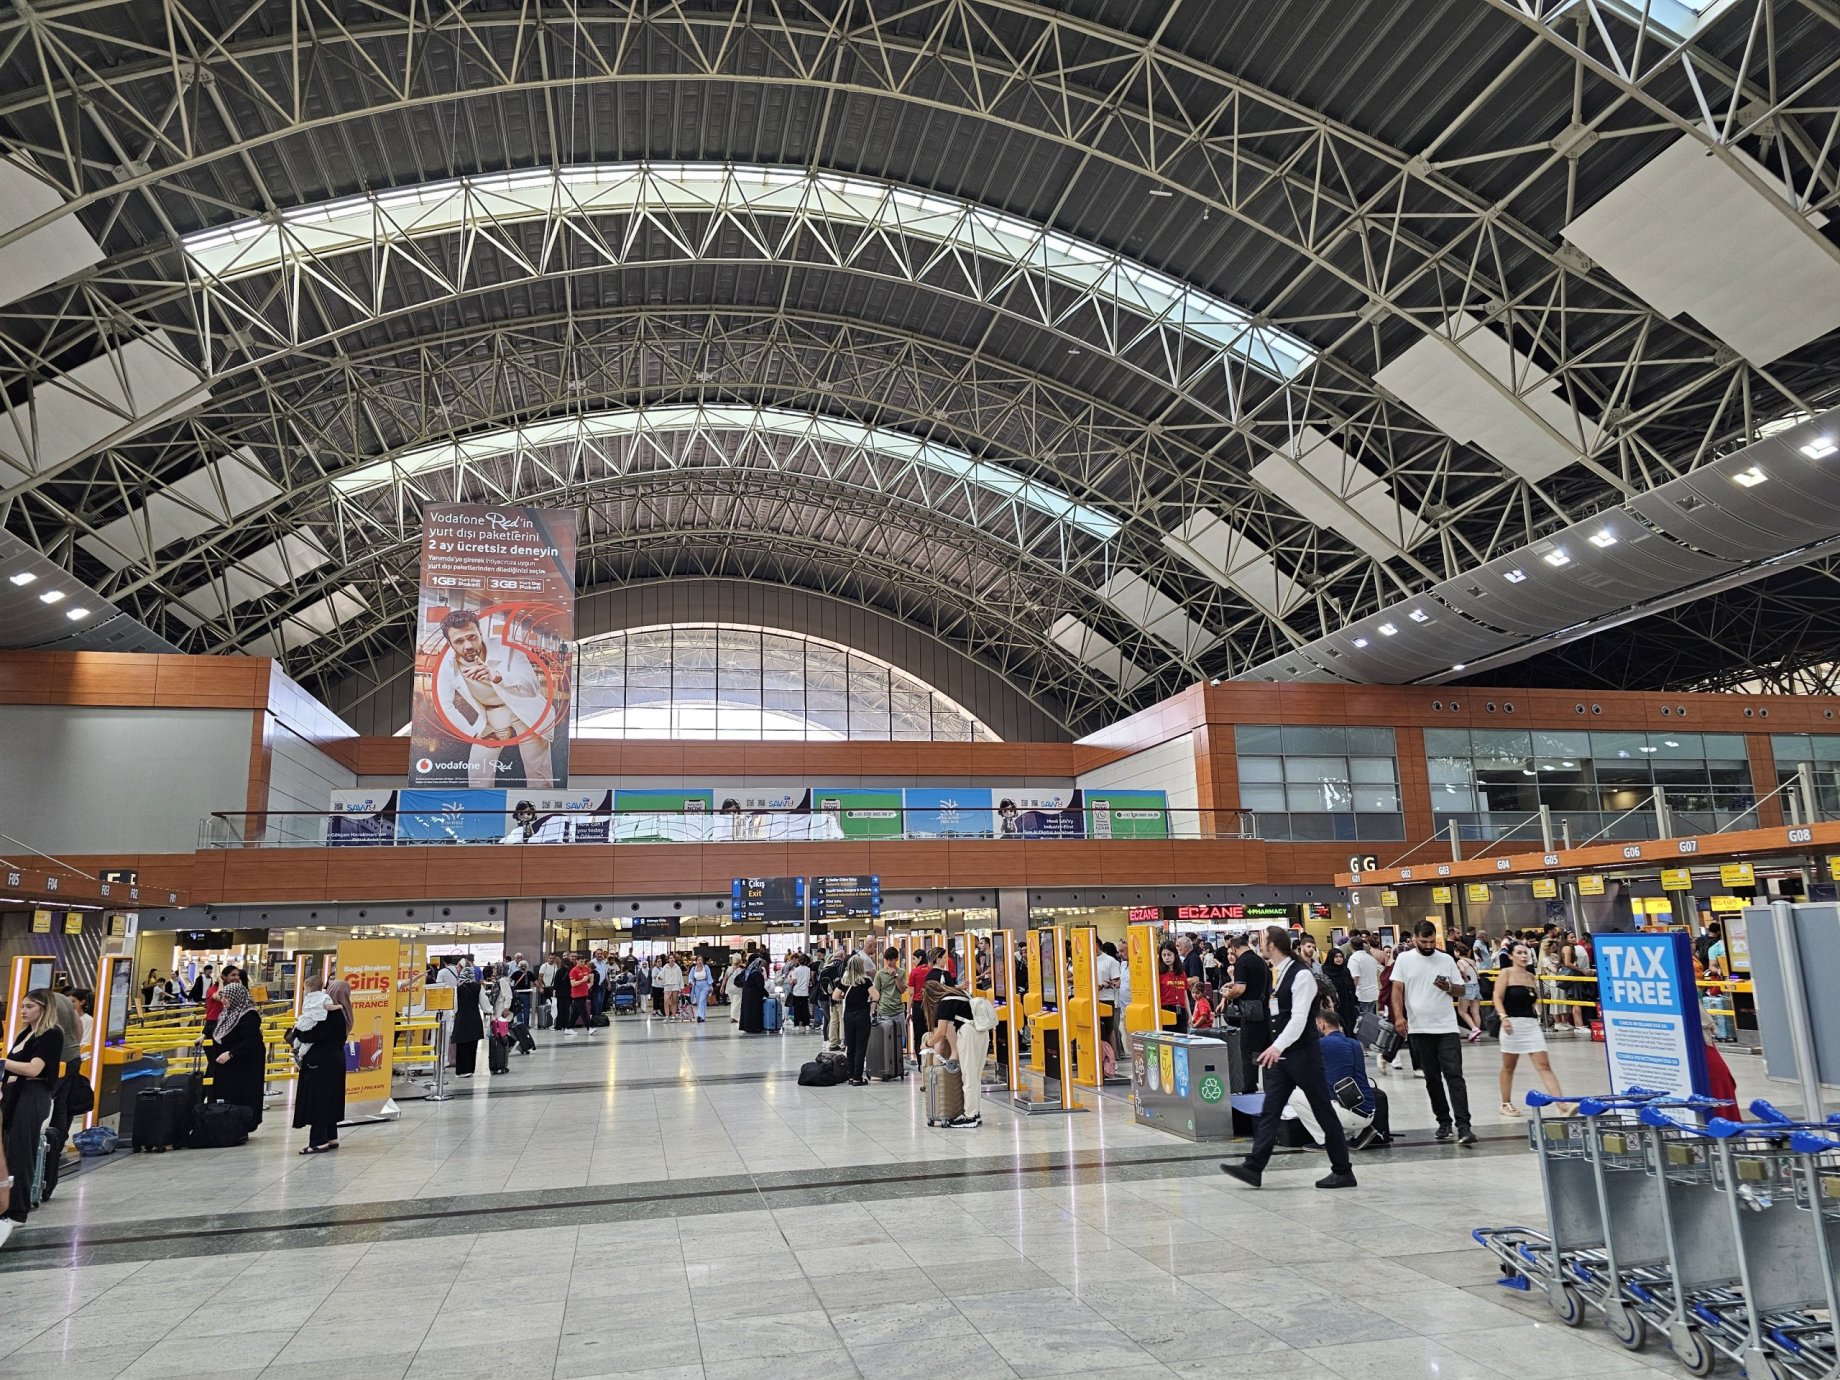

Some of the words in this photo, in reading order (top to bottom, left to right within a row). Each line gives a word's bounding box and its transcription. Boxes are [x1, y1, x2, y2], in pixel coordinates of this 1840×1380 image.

[430, 512, 485, 526] Vodafone
[429, 528, 454, 538] yurt
[456, 529, 476, 540] dışı
[479, 530, 540, 542] paketlerini
[428, 540, 436, 549] 2
[439, 542, 454, 552] ay
[457, 542, 507, 554] ücretsiz
[510, 545, 558, 558] deneyin
[432, 576, 456, 586] 1GB
[490, 580, 517, 589] 3GB
[435, 761, 480, 770] vodafone
[489, 760, 512, 772] Red
[1789, 829, 1811, 842] G08
[1680, 840, 1696, 852] G07
[1624, 847, 1640, 858] G06
[1350, 858, 1359, 873] G
[1364, 857, 1376, 872] G
[1497, 860, 1510, 869] G04
[1544, 855, 1559, 865] G05
[1401, 870, 1412, 878] G02
[1439, 866, 1450, 875] G03
[8, 873, 20, 886] F05
[48, 878, 58, 890] F04
[748, 880, 765, 889] Çıkış
[1352, 875, 1360, 883] G01
[101, 885, 110, 896] F03
[130, 888, 138, 899] F02
[1352, 892, 1360, 904] G
[1130, 908, 1158, 920] ECZANE
[1178, 907, 1243, 918] ECZANE
[1602, 946, 1669, 979] TAX
[344, 966, 363, 974] Bagaj
[344, 972, 390, 993] Giriş
[1612, 980, 1672, 1006] FREE
